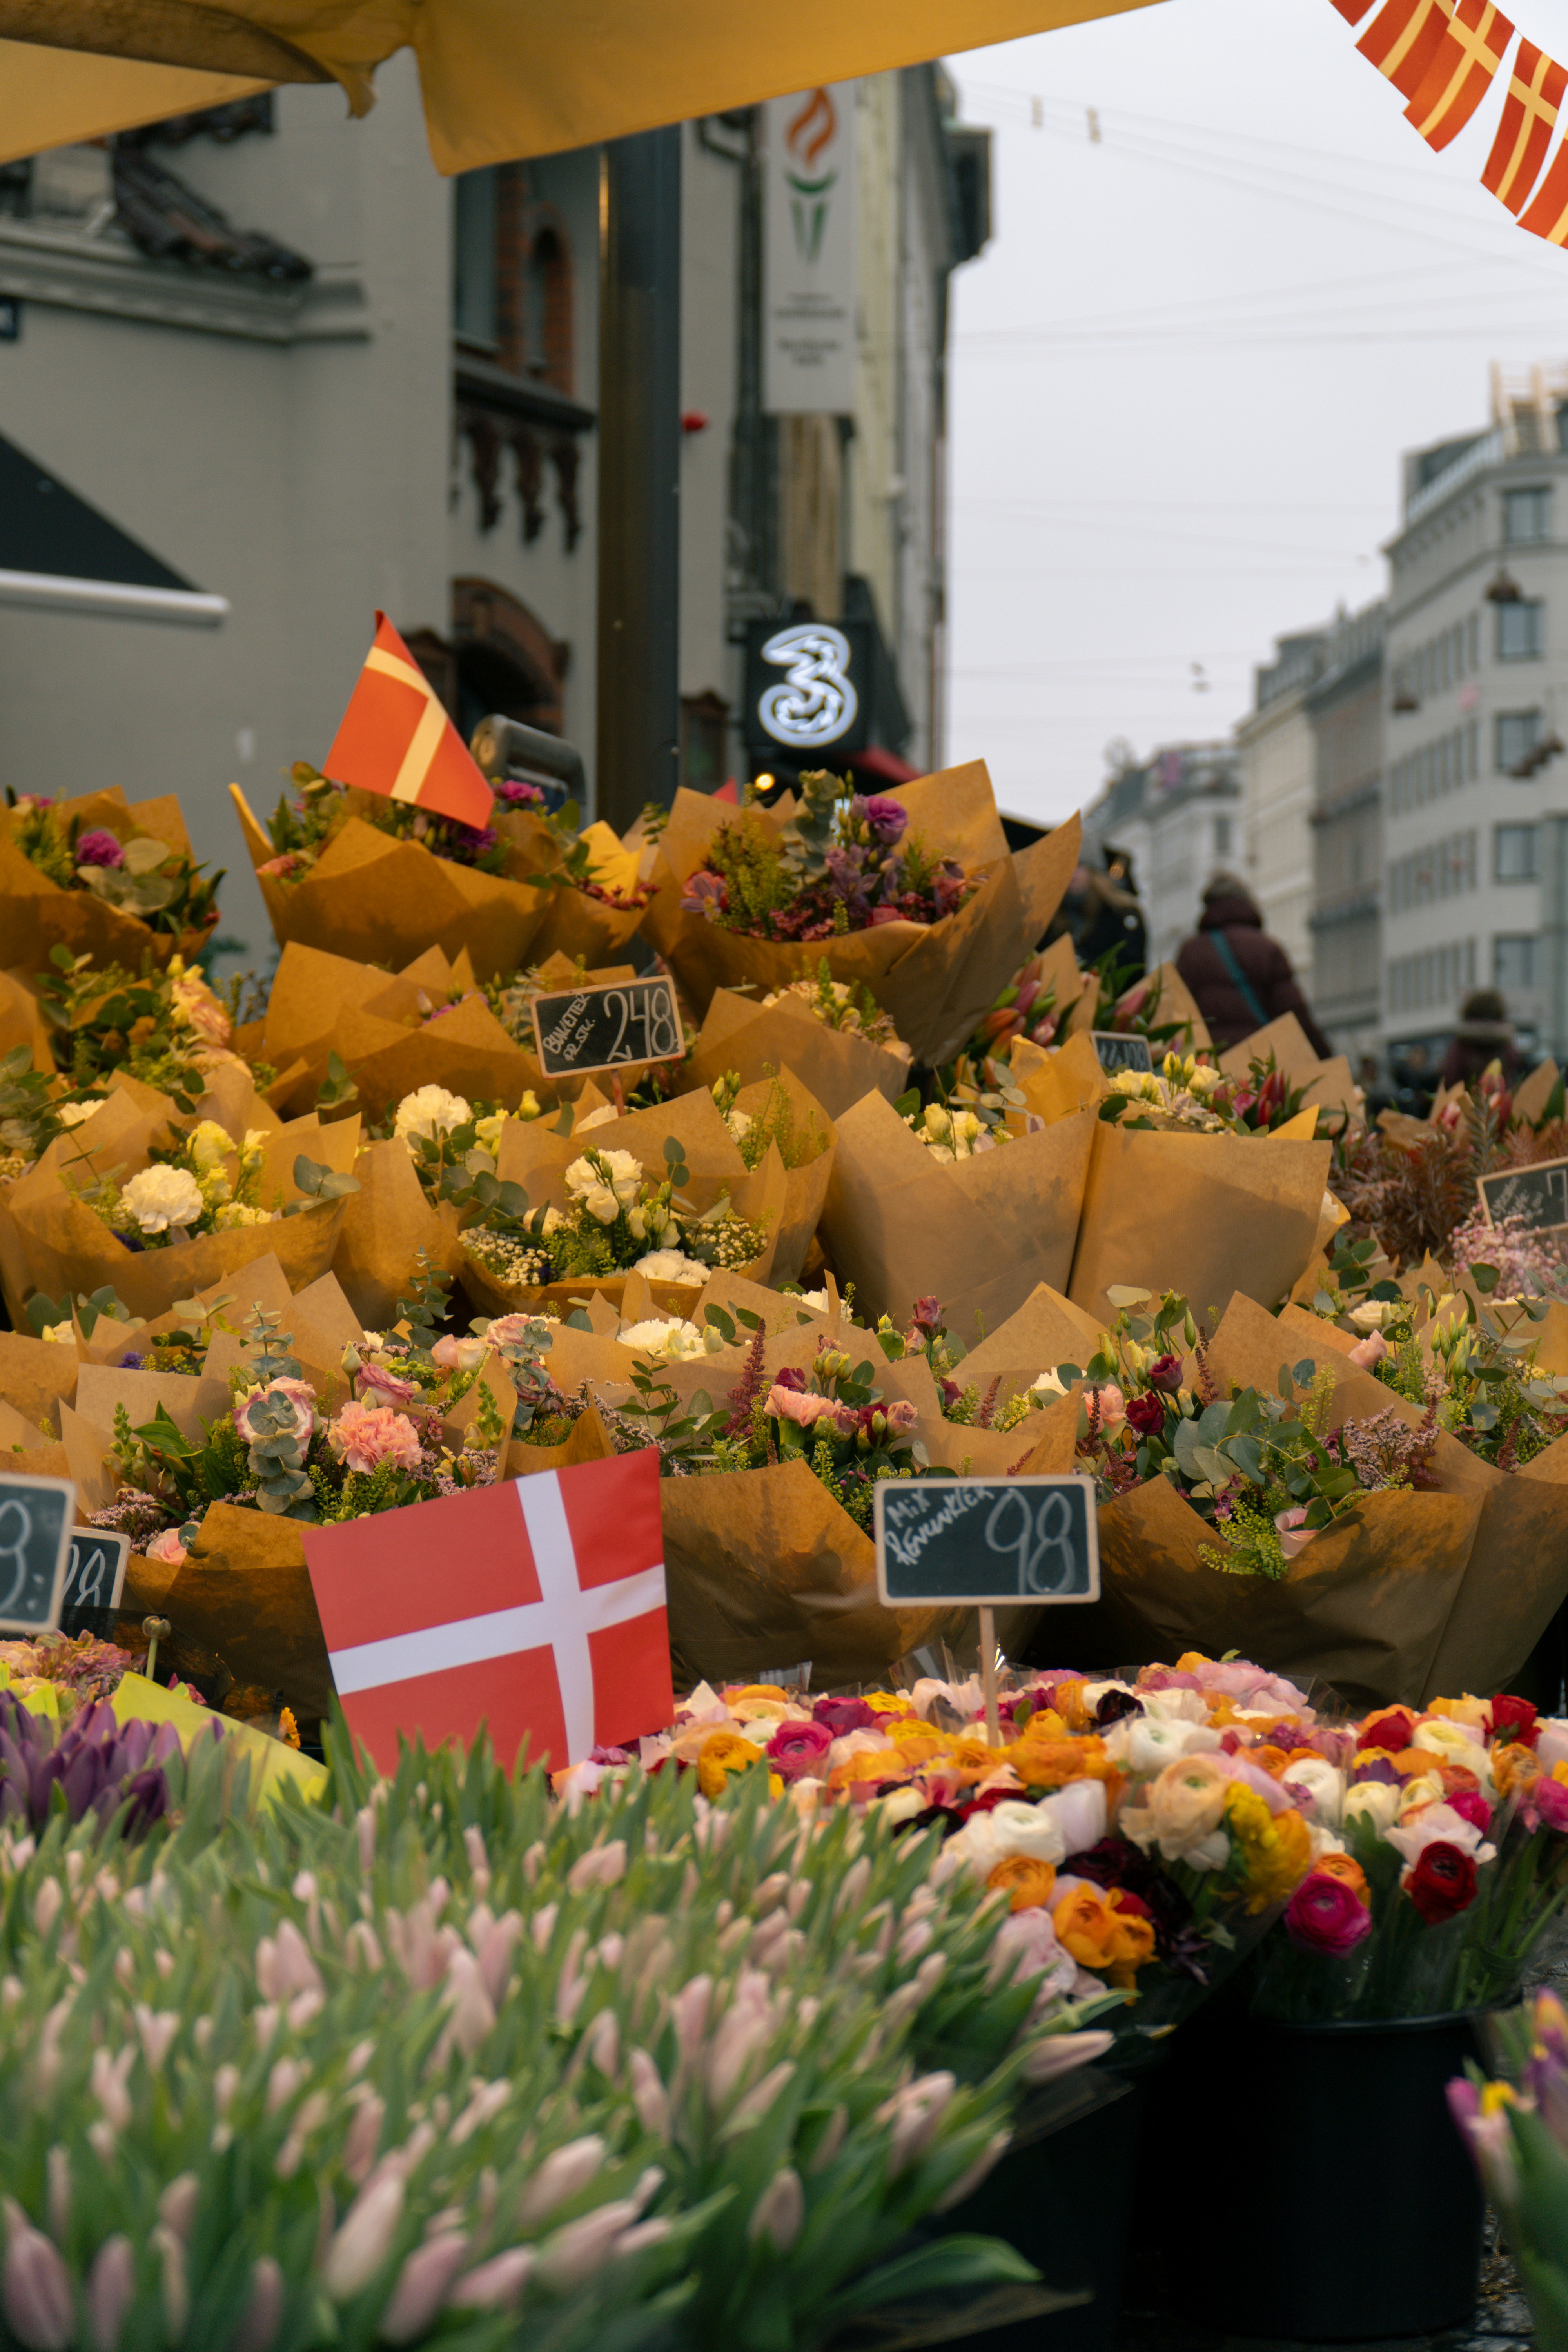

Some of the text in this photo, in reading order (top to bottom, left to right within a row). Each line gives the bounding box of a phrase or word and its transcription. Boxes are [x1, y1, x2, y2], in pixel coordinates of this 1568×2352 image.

[759, 624, 857, 747] 3
[603, 987, 674, 1062] 248
[985, 1488, 1076, 1595] 98
